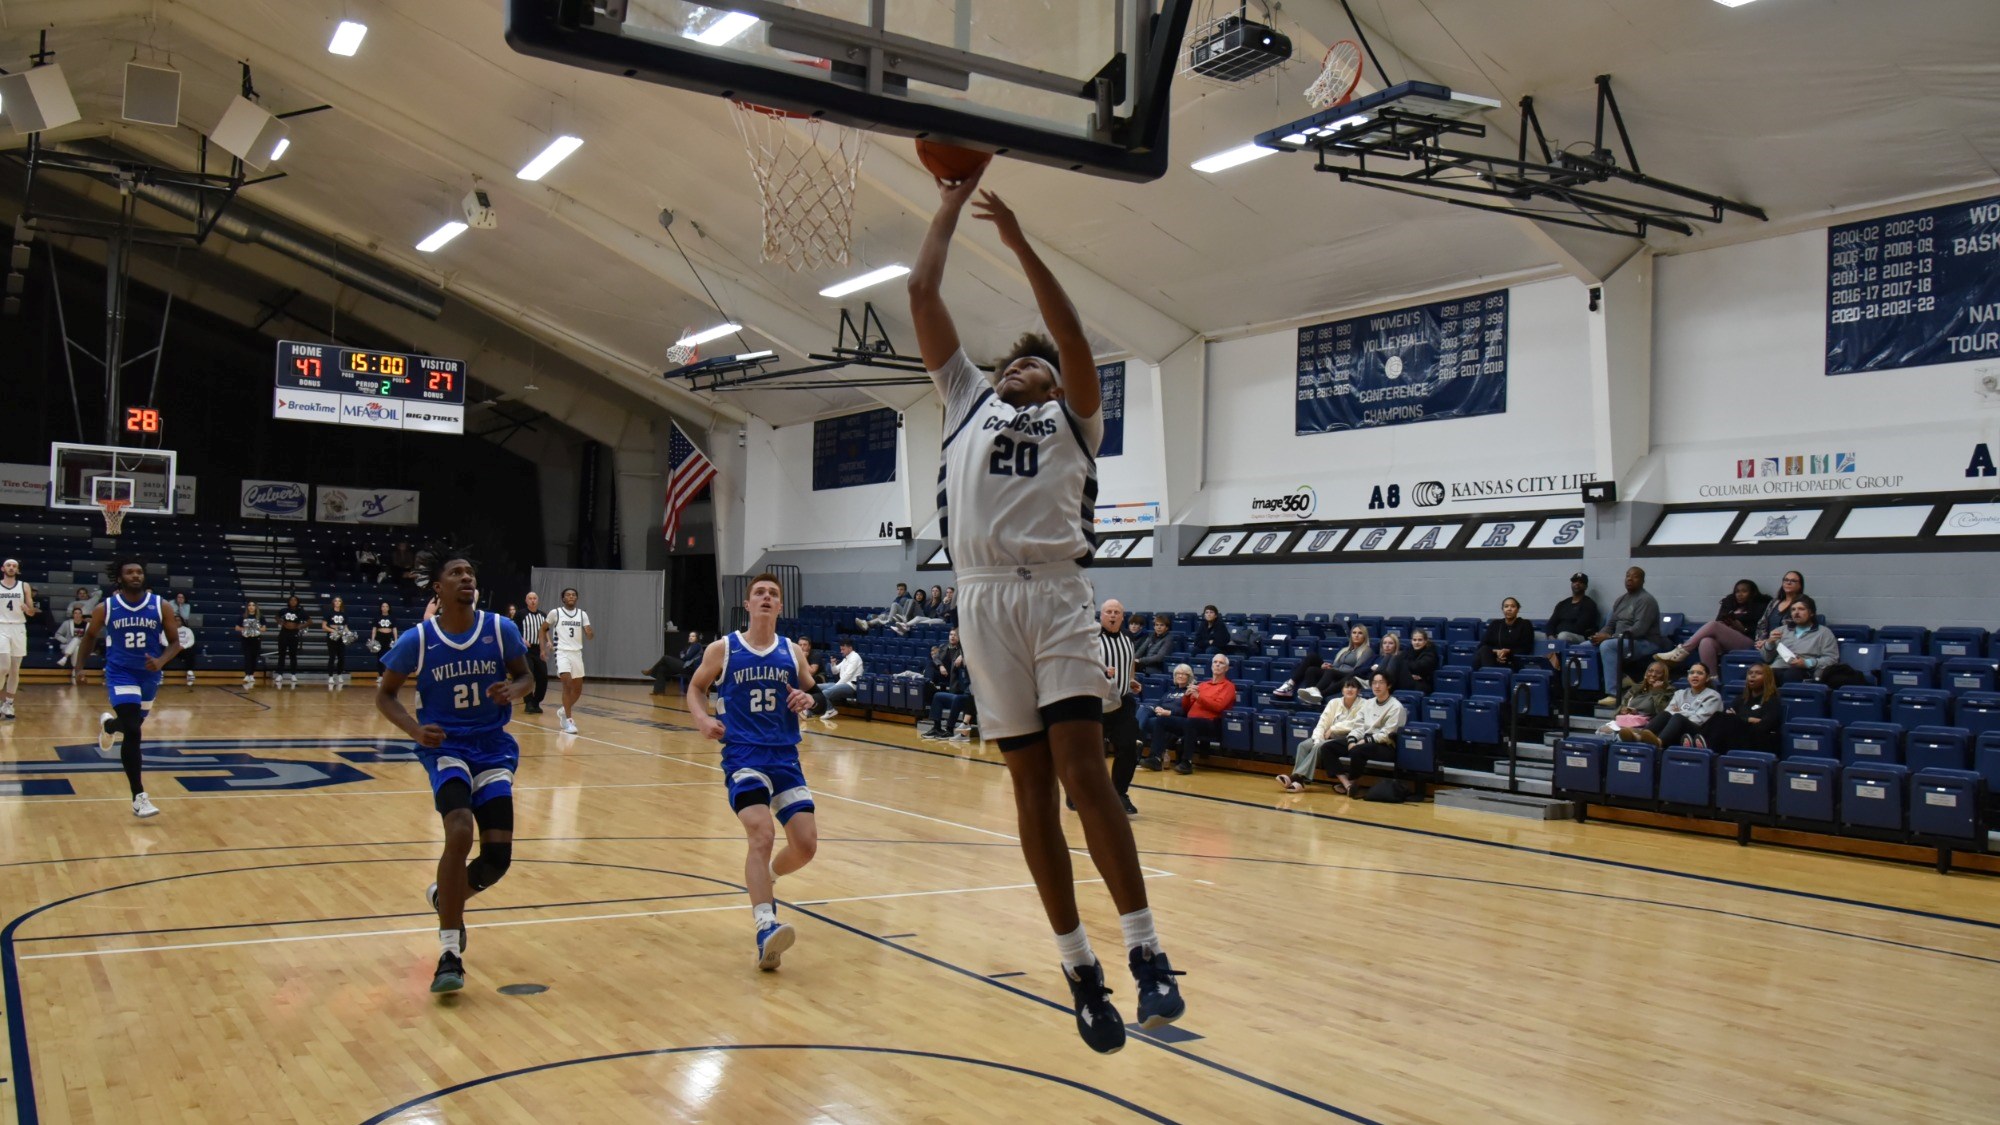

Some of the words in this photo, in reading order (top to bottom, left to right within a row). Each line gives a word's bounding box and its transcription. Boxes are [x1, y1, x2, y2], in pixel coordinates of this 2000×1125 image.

[1833, 226, 1879, 246] 2001-02
[1885, 217, 1933, 237] 2002-03
[1833, 247, 1878, 266] 2006-07
[1884, 238, 1933, 258] 2008-09
[1833, 267, 1876, 286] 2011-12
[1882, 258, 1932, 279] 2012-13
[1832, 286, 1878, 305] 2016-17
[1882, 278, 1931, 298] 2017-18
[1441, 305, 1458, 318] 1991
[1463, 300, 1481, 314] 1992
[1486, 296, 1504, 309] 1993
[1832, 304, 1878, 324] 2020-21
[1882, 296, 1934, 316] 2021-22
[1370, 312, 1420, 331] WOMEN'S
[1463, 316, 1480, 330] 1998
[292, 345, 322, 357] HOME
[1363, 331, 1428, 353] VOLLEYBALL
[1485, 346, 1502, 358] 2011
[296, 358, 321, 377] 47
[352, 353, 403, 375] 15:00
[421, 359, 458, 371] VISITOR
[1460, 364, 1480, 377] 2017
[1484, 361, 1504, 374] 2018
[299, 379, 321, 387] BONUS
[356, 380, 379, 389] PERIOD
[381, 380, 390, 394] 2
[429, 371, 453, 391] 27
[423, 391, 444, 399] BONUS
[1360, 382, 1428, 403] CONFERENCE
[128, 408, 157, 432] 28
[379, 408, 399, 420] OIL
[406, 412, 422, 420] BIG
[1364, 404, 1424, 422] CHAMPIONS
[982, 414, 1057, 436] COUGARS
[990, 435, 1039, 478] 20
[1965, 443, 1997, 477] A
[1452, 479, 1514, 497] KANSAS
[1518, 476, 1558, 492] CITY
[1700, 482, 1758, 497] COLUMBIA
[1763, 478, 1852, 494] ORTHOPAEDIC
[1856, 476, 1904, 489] GROUP
[1252, 494, 1310, 512] image360
[1368, 484, 1400, 509] A8
[879, 522, 894, 538] A6
[6, 600, 13, 611] 4
[112, 617, 157, 630] WILLIAMS
[568, 628, 574, 638] 3
[125, 632, 146, 648] 22
[431, 659, 497, 682] WILLIAMS
[733, 666, 790, 684] WILLIAMS
[453, 682, 480, 708] 21
[750, 688, 776, 713] 25
